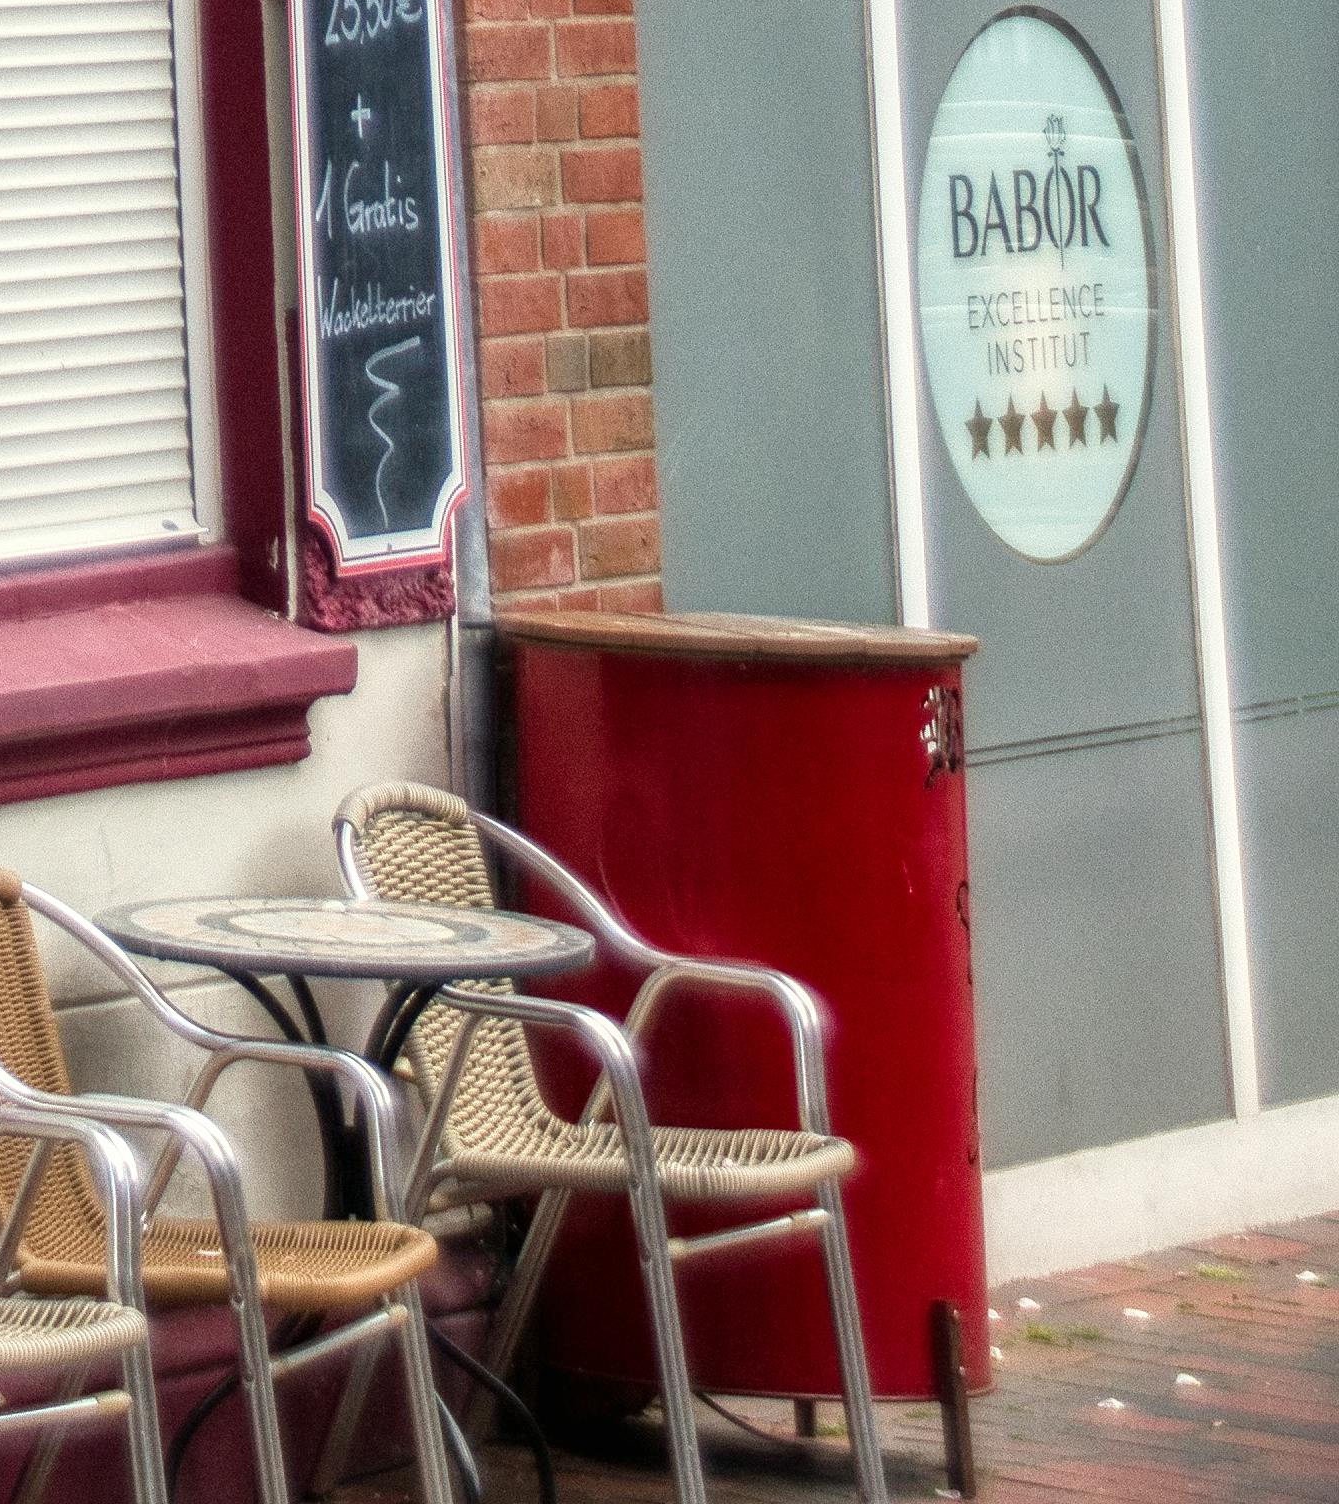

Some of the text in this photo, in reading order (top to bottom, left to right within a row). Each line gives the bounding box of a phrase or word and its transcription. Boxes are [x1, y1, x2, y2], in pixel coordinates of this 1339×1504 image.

[316, 158, 419, 239] 1 Gratis
[949, 163, 1110, 259] BABOR
[317, 275, 435, 339] Wackelterrier
[967, 283, 1105, 329] EXCELLENCE
[987, 332, 1090, 376] INSTITUT
